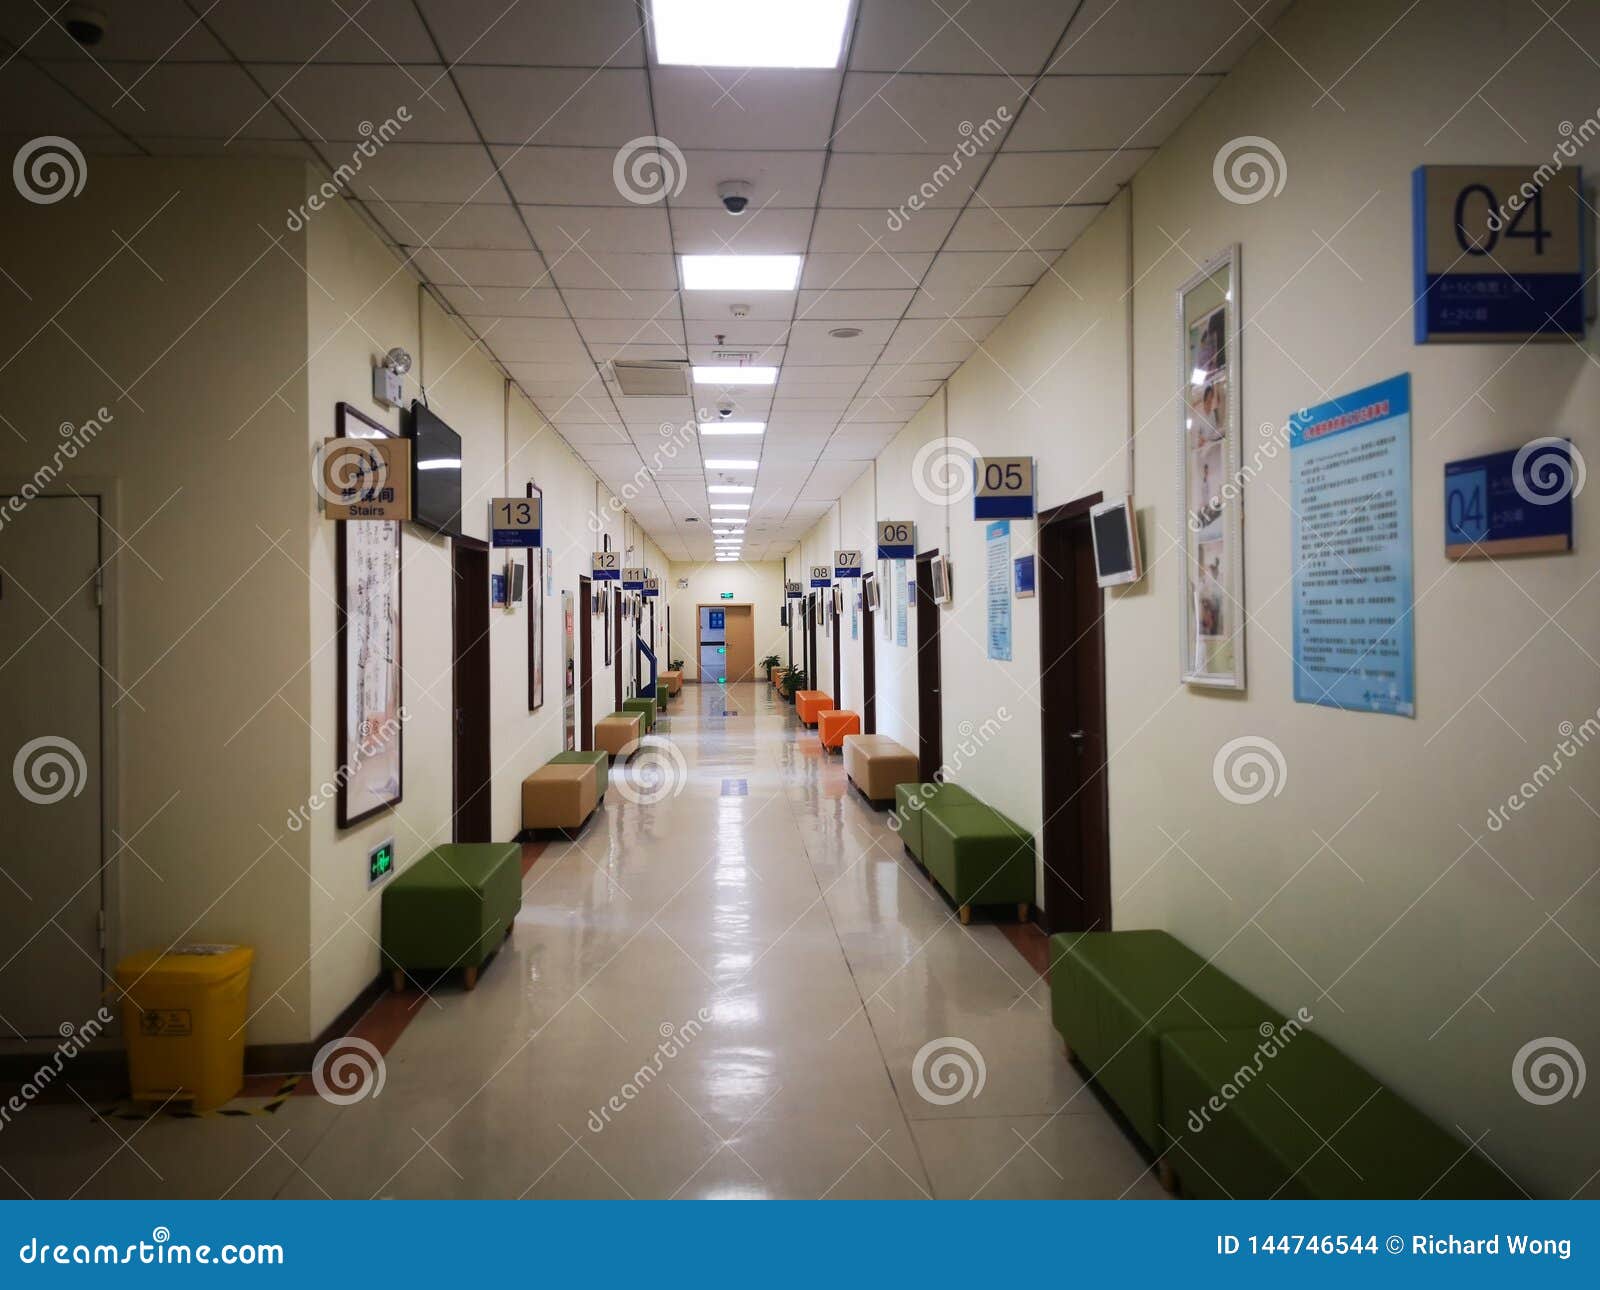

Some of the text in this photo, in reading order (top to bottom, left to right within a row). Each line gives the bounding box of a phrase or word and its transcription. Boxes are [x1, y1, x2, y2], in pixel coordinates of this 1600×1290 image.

[1454, 184, 1552, 255] 04
[985, 463, 1023, 490] 05
[349, 505, 385, 516] Stairs
[502, 503, 531, 525] 13
[1448, 485, 1484, 533] 04
[884, 525, 908, 542] 06
[598, 554, 615, 568] 12
[839, 553, 857, 565] 07
[627, 570, 640, 581] 11
[813, 567, 828, 578] 08
[645, 579, 656, 589] 10
[789, 583, 800, 592] 09
